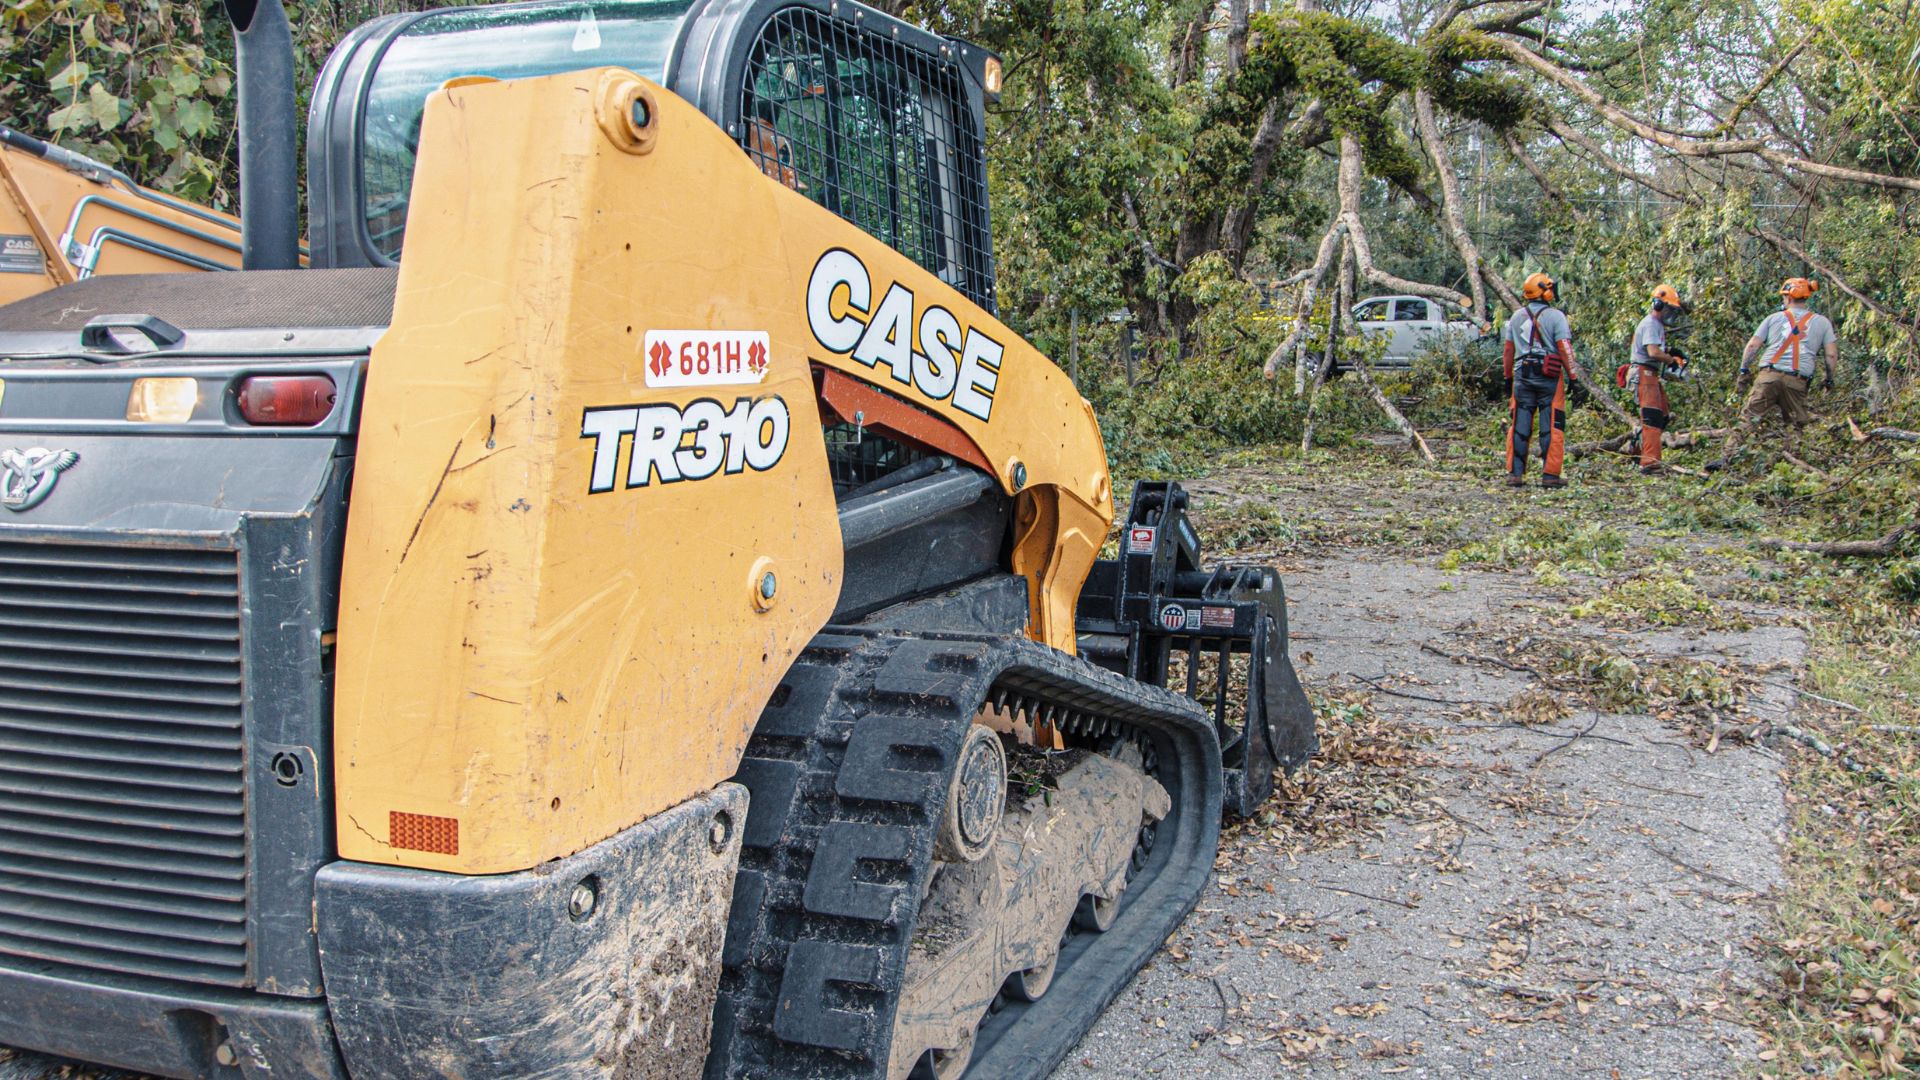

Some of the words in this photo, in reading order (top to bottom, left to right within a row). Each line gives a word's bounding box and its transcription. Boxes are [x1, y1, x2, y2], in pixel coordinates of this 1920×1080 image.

[679, 340, 741, 376] 681H
[806, 246, 1005, 423] CASE
[579, 393, 790, 495] TR310
